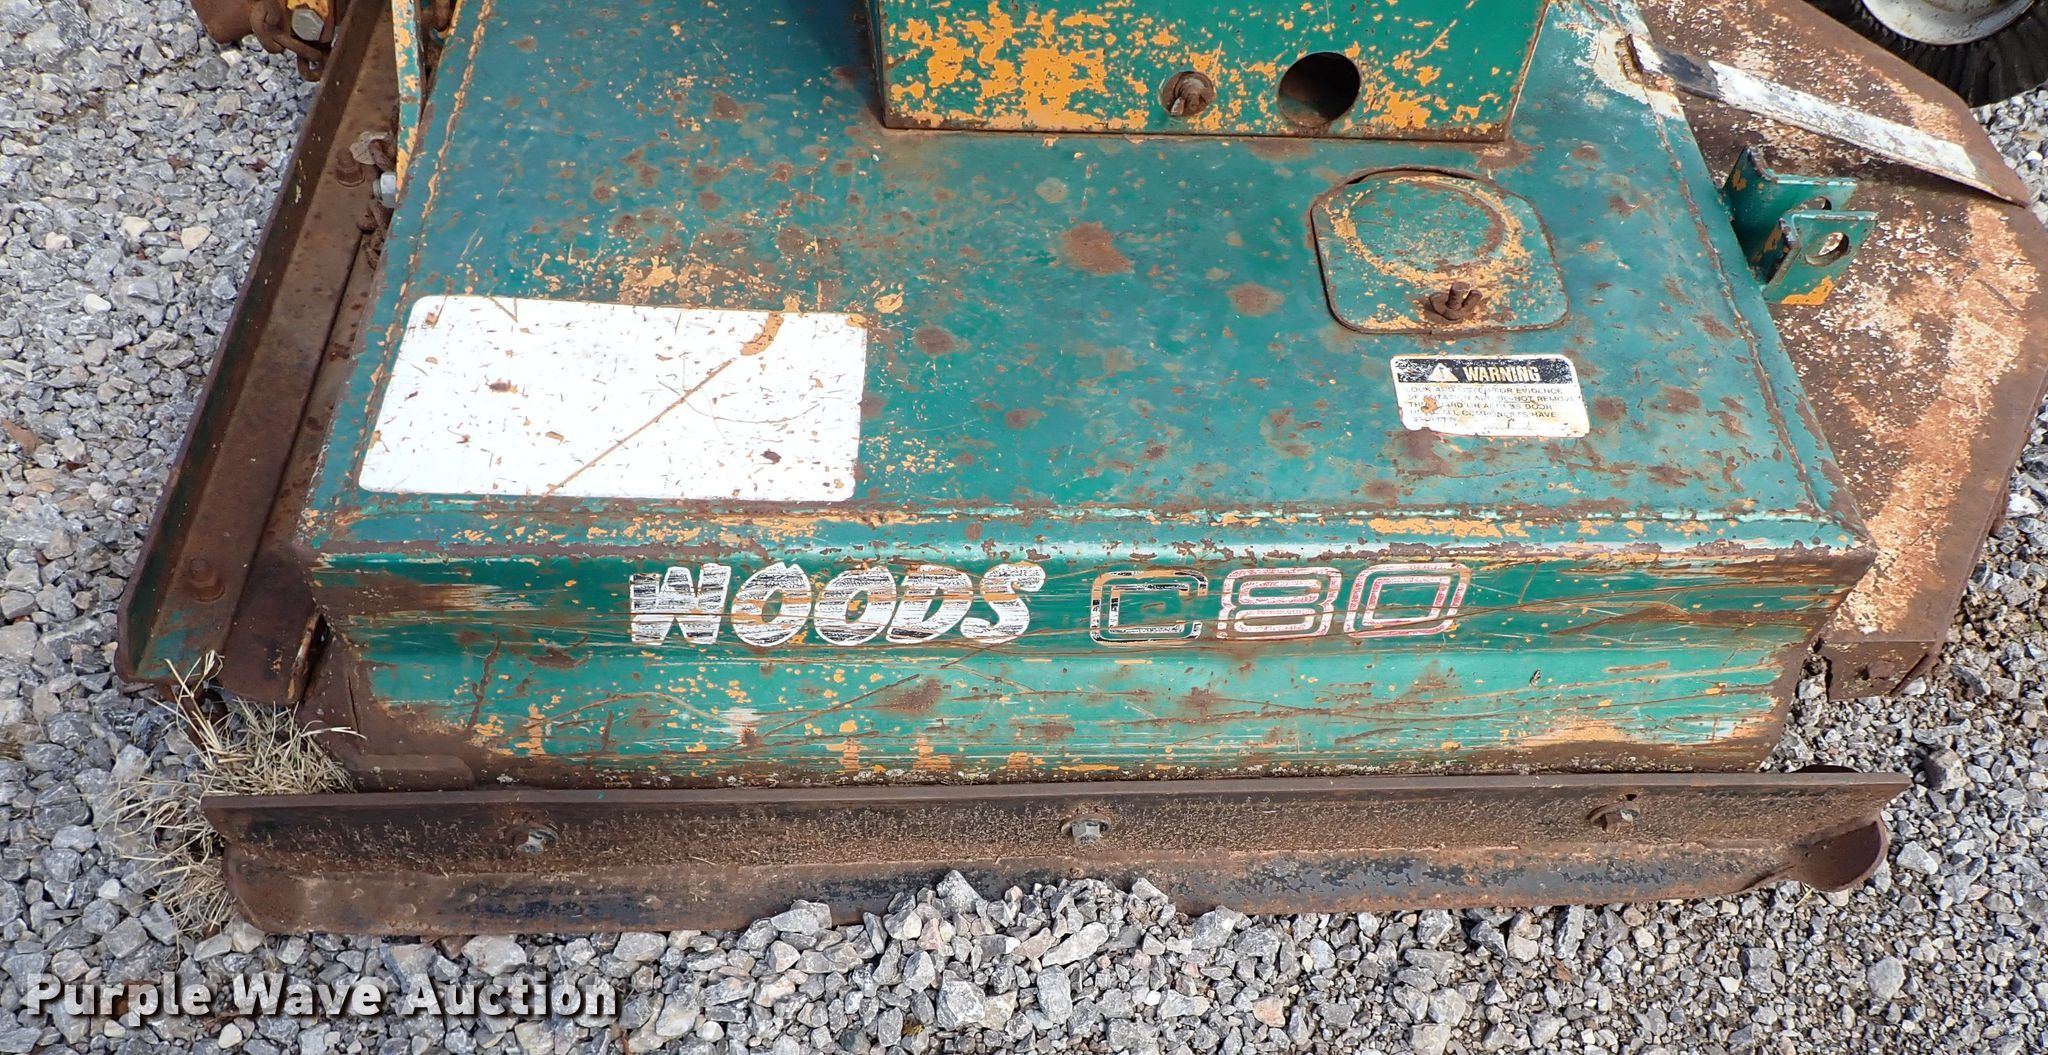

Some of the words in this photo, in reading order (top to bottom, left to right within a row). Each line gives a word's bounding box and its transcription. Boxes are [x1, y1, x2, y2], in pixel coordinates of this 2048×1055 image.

[1463, 366, 1541, 382] WARNING
[629, 562, 1046, 646] WOODS
[1090, 564, 1471, 646] C80
